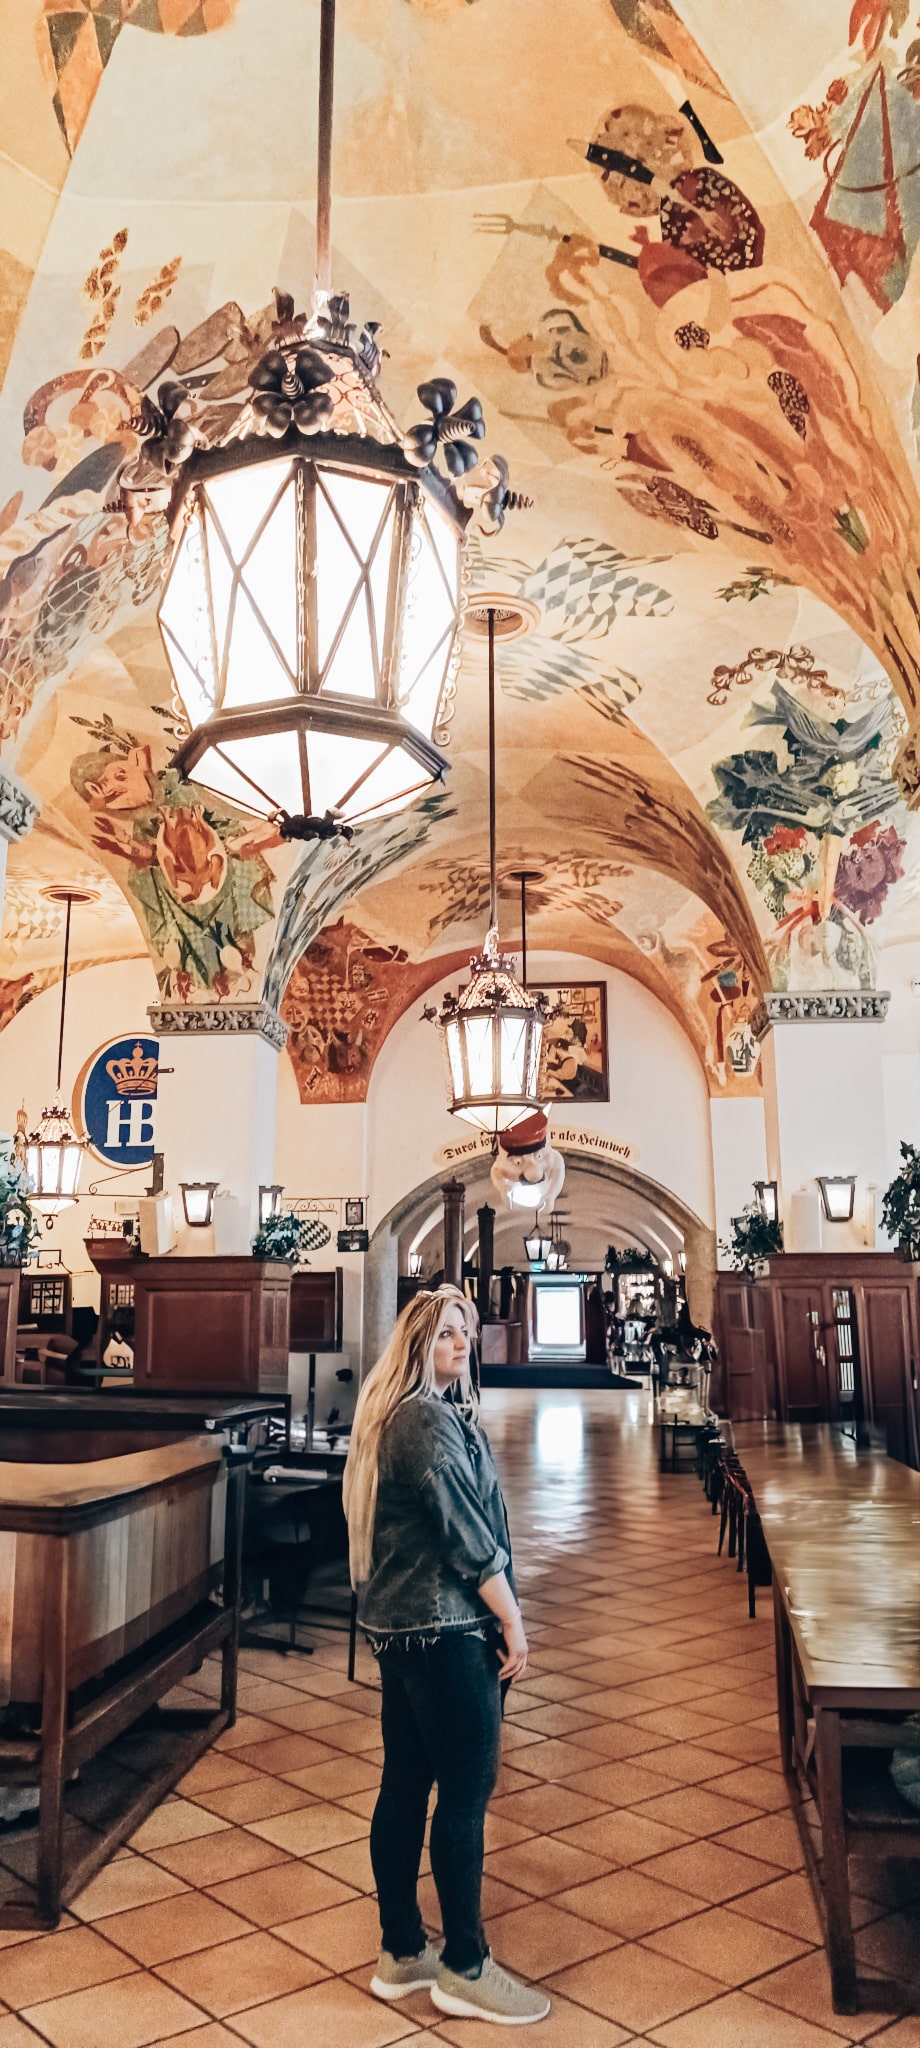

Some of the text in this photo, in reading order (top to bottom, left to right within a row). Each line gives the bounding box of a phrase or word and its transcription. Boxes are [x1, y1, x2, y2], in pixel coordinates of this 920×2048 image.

[104, 1099, 157, 1147] HB
[443, 1140, 477, 1159] Durst
[558, 1130, 576, 1141] als
[577, 1133, 631, 1158] Heimweh
